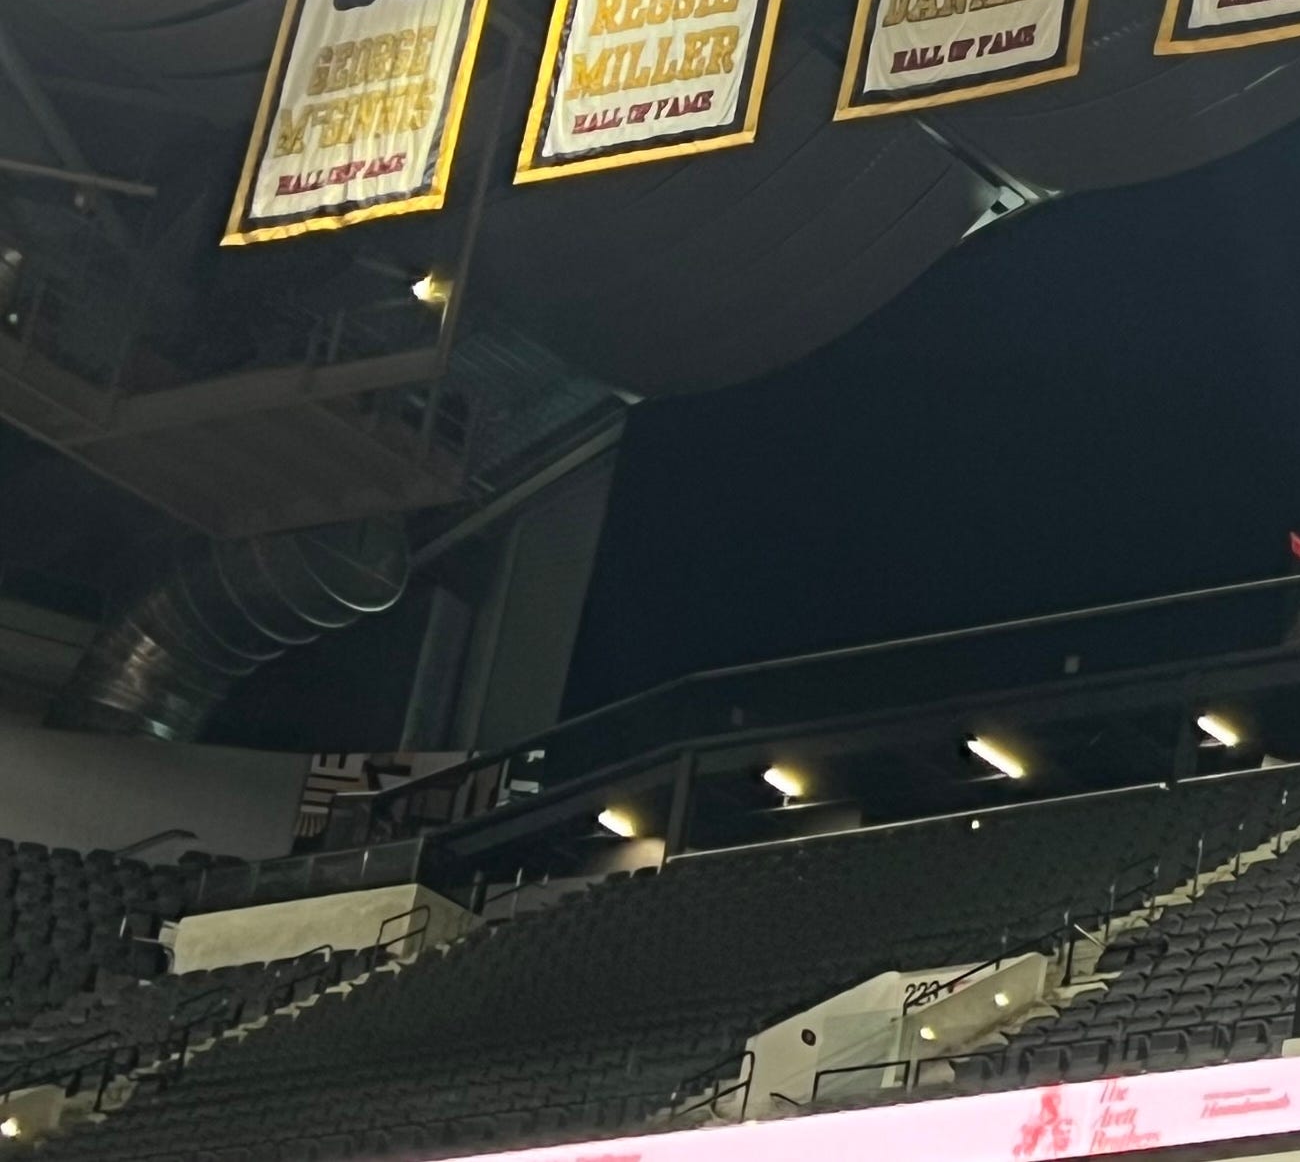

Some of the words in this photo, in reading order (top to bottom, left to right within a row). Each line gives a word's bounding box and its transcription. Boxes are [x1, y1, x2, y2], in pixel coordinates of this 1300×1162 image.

[564, 25, 740, 100] MILLER
[890, 45, 944, 74] HALL
[976, 24, 1036, 57] FAME
[572, 107, 624, 134] HALL
[627, 101, 653, 124] OF
[654, 90, 714, 120] FAME
